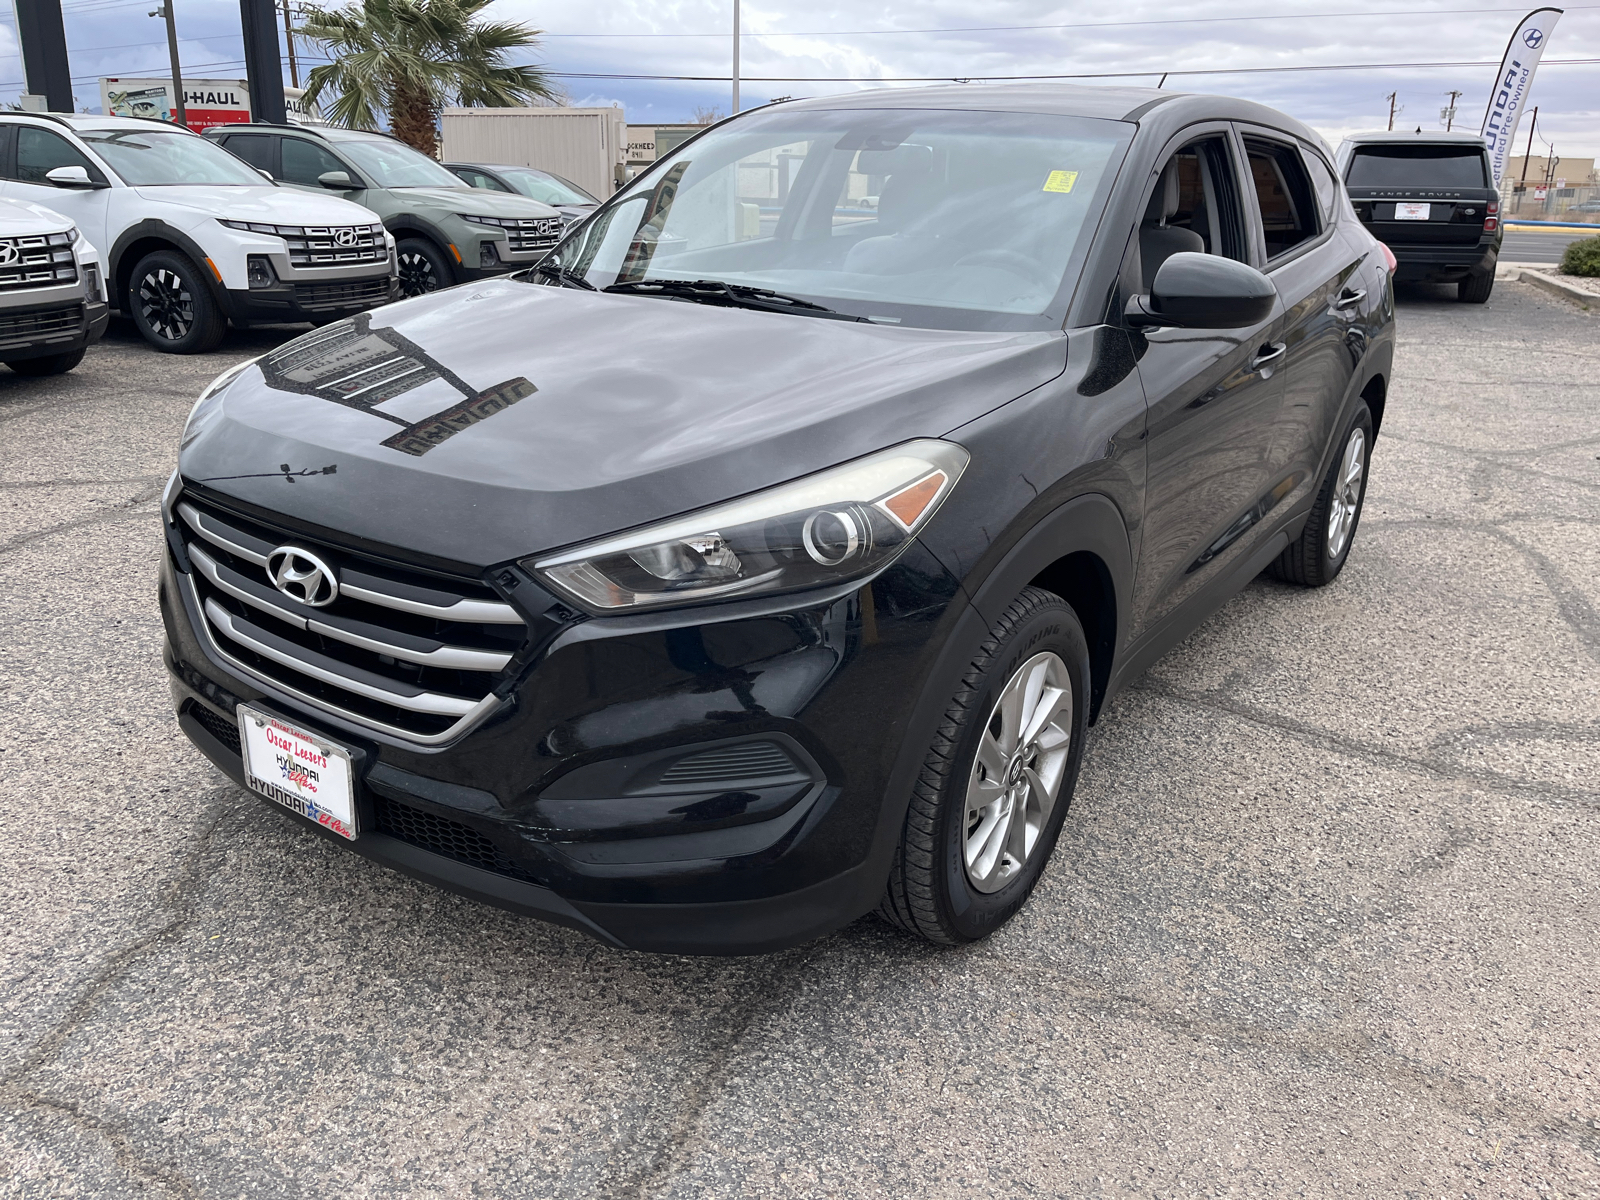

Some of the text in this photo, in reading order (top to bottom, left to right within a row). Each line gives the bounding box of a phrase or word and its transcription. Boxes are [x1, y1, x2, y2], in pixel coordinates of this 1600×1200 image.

[1486, 60, 1521, 150] UNDAI
[1501, 68, 1529, 136] Pre-Owned
[627, 142, 655, 150] OCKHEED
[631, 151, 643, 159] 8411
[266, 728, 327, 769] Oscar Leeser's
[276, 754, 320, 783] HYUNDAI
[250, 775, 306, 815] HYUNDAI
[319, 813, 332, 825] El
[330, 820, 350, 838] Paso
